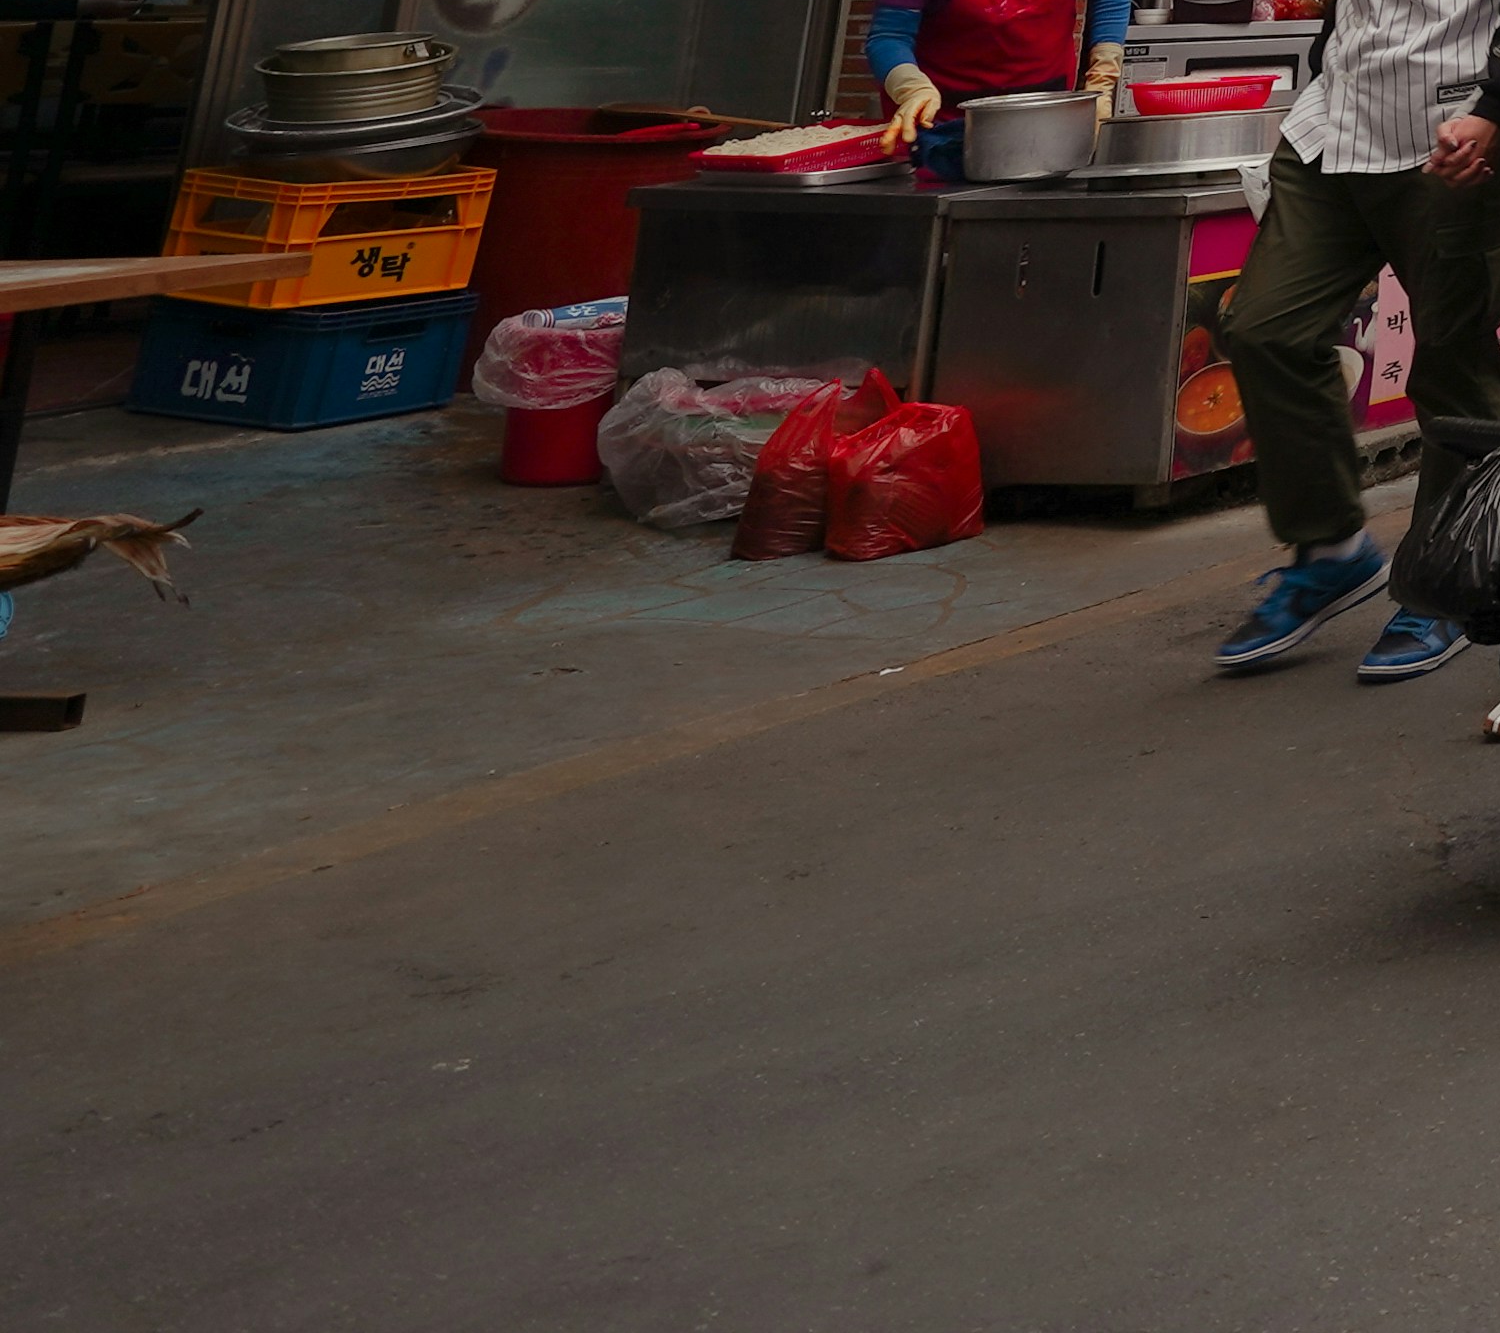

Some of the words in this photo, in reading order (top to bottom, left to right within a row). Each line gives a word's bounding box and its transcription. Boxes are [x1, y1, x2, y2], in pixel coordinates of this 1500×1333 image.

[350, 245, 411, 283] 생탁
[180, 356, 254, 404] 대선
[364, 347, 407, 376] 대선
